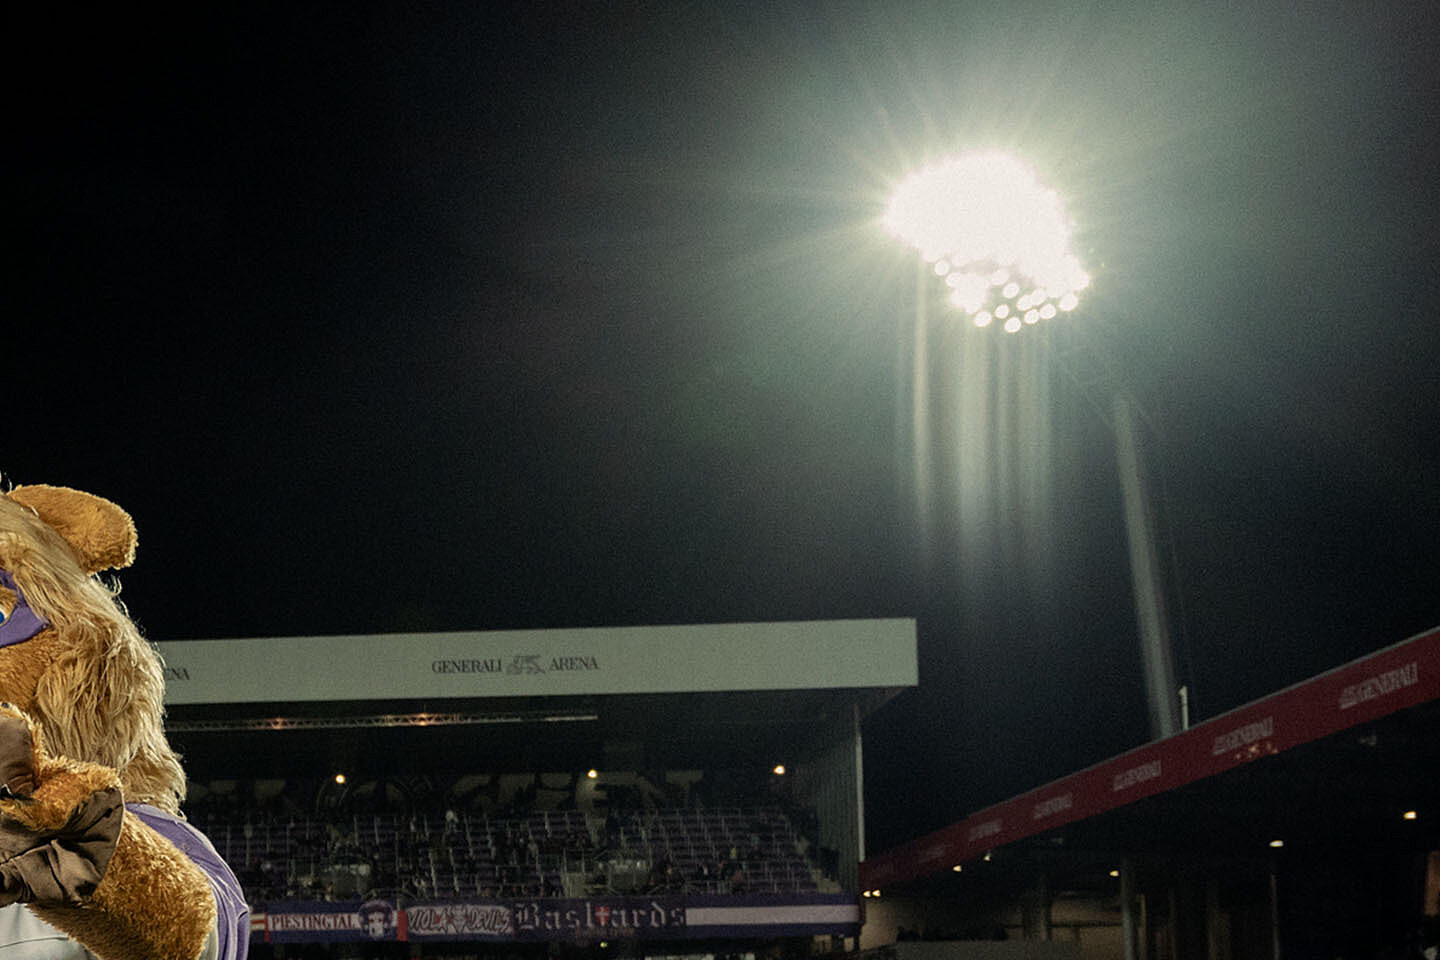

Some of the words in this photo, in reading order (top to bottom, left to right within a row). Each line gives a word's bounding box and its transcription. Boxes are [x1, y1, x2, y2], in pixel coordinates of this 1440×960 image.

[430, 658, 502, 675] GENERALI
[549, 655, 599, 671] ARENA
[407, 907, 449, 934] VIOLA
